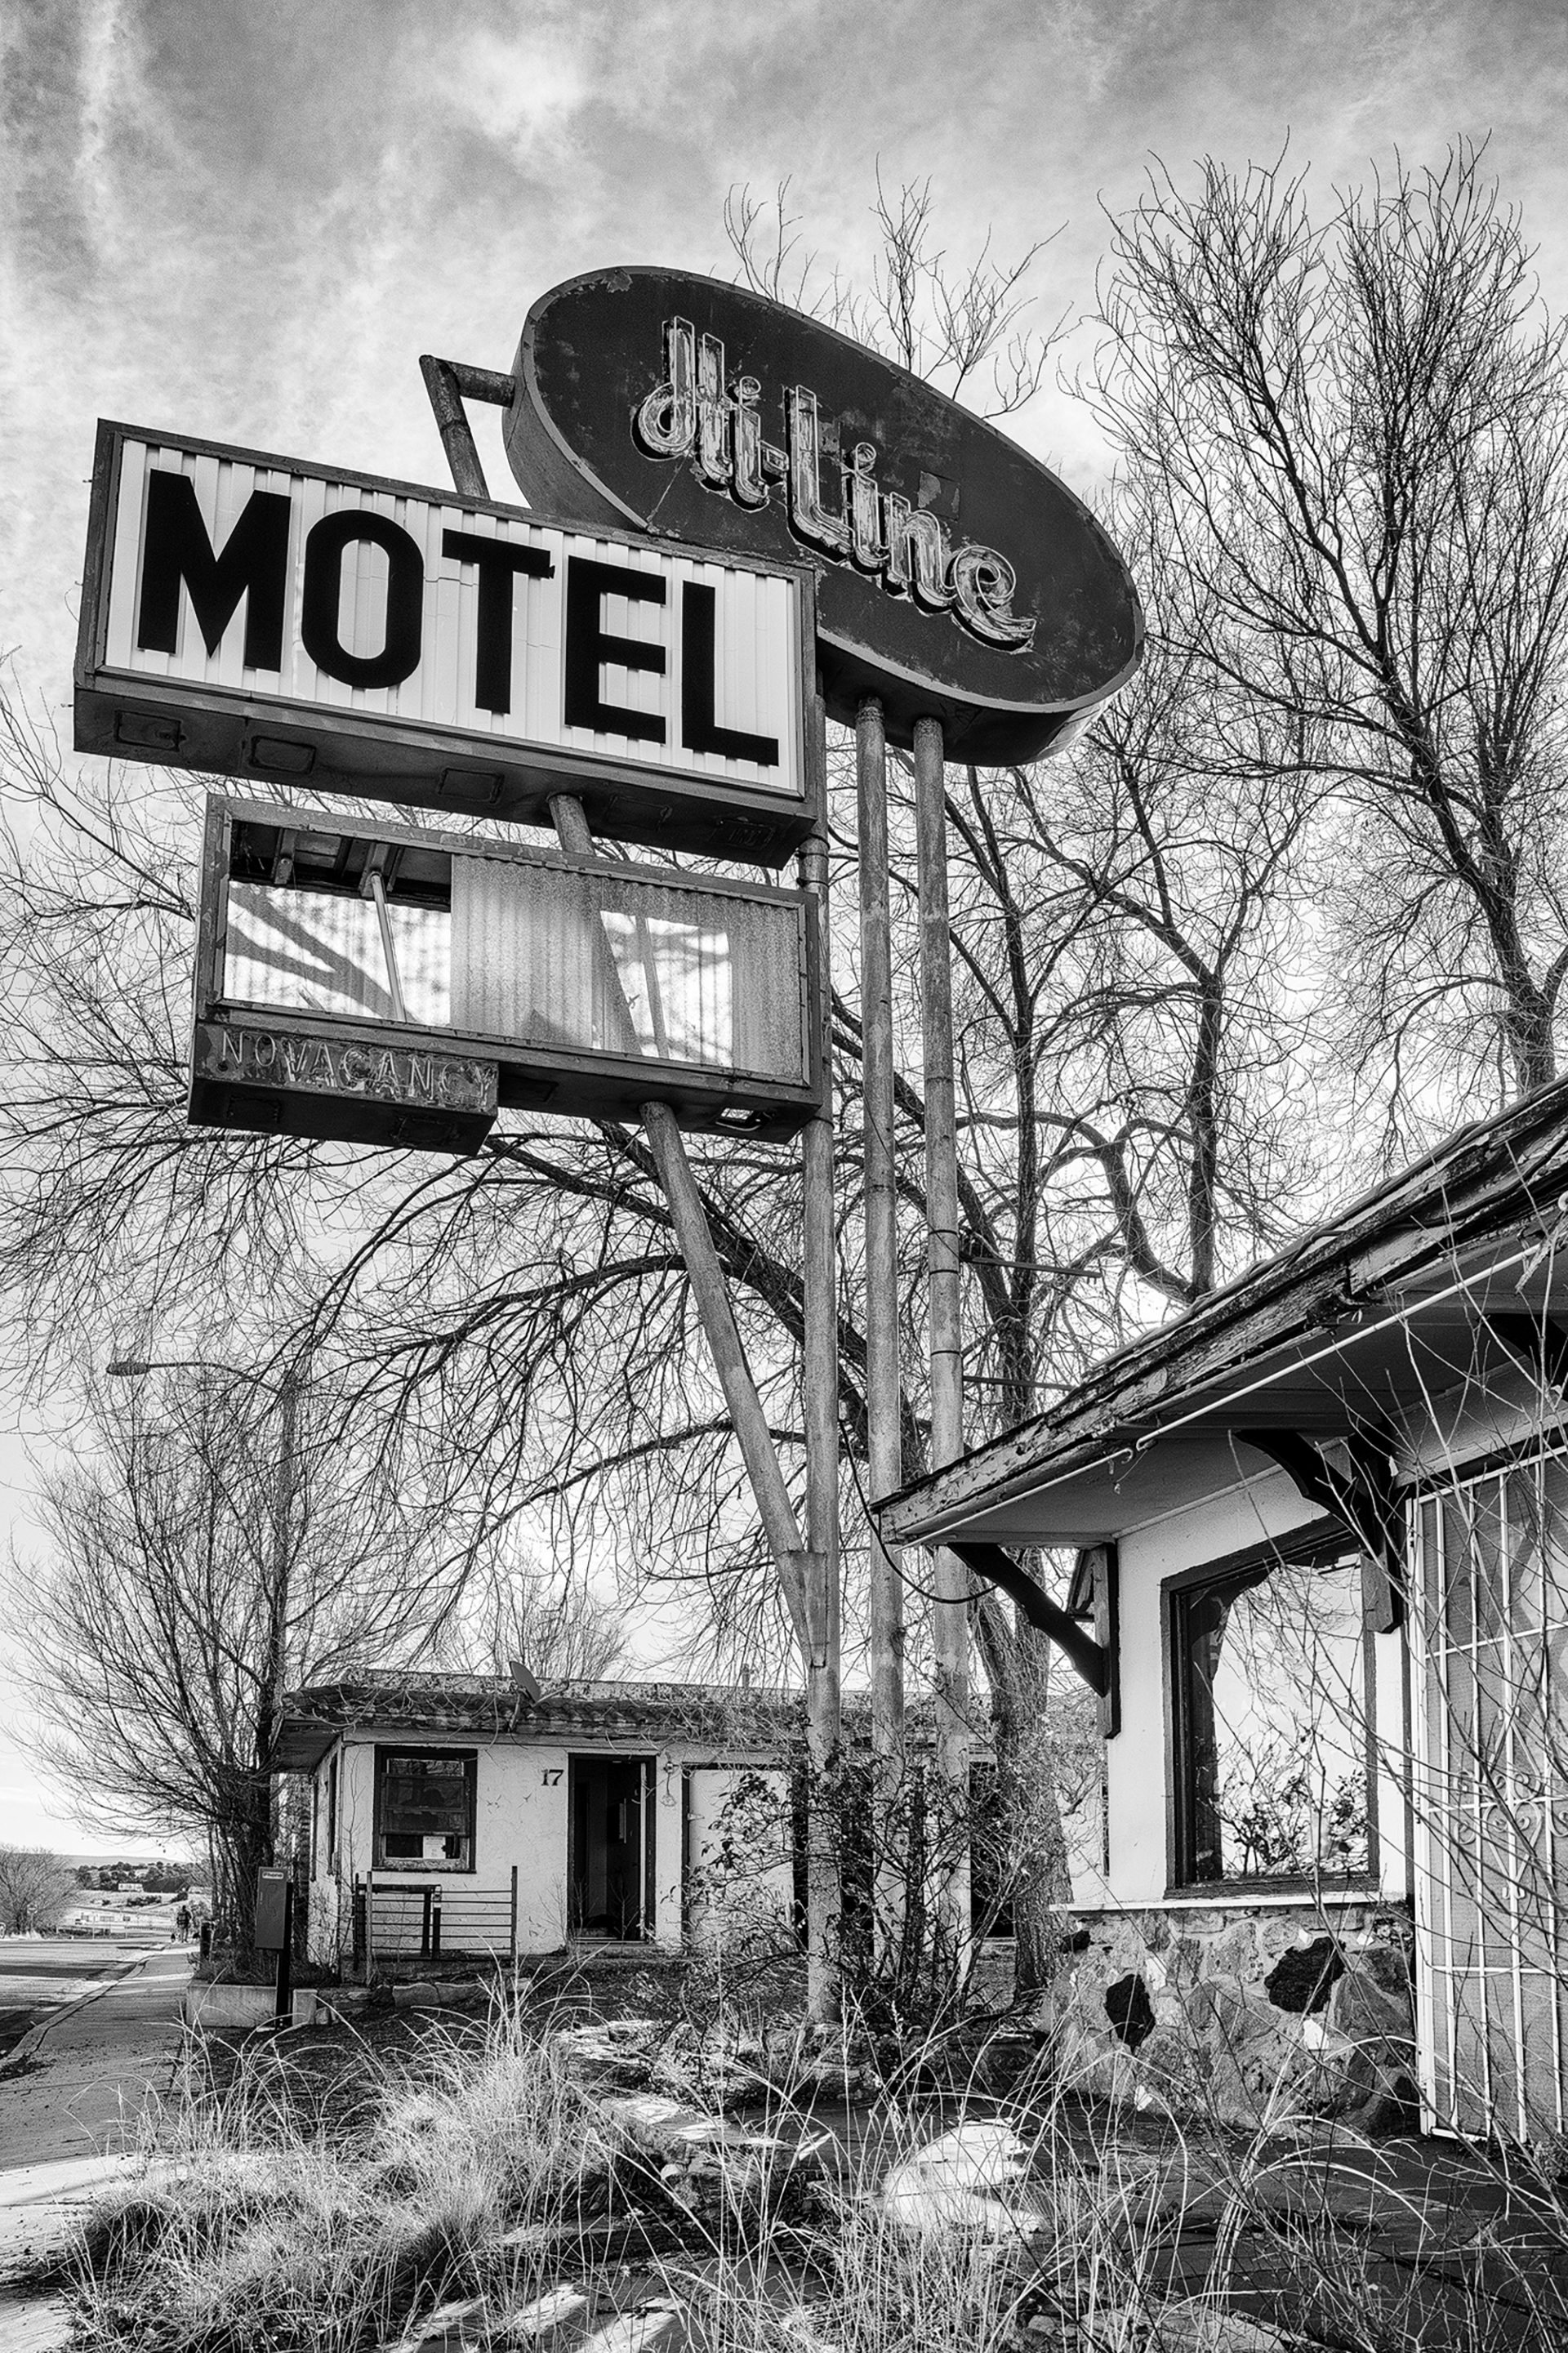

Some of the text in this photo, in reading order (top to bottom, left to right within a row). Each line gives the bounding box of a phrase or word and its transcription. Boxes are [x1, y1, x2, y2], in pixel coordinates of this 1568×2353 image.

[634, 315, 1036, 652] Hi-Line
[136, 468, 779, 766] MOTEL
[221, 1030, 497, 1106] NO VACANCY
[541, 1769, 565, 1786] 17
